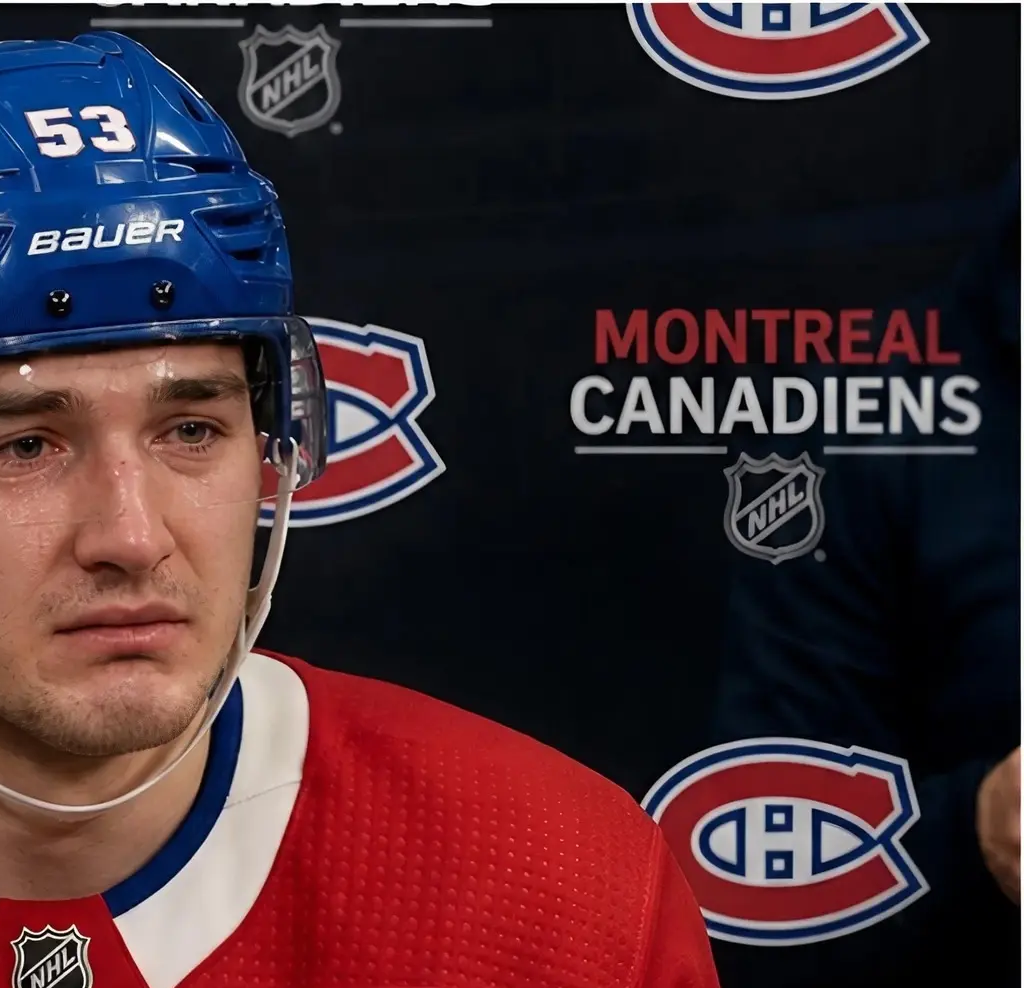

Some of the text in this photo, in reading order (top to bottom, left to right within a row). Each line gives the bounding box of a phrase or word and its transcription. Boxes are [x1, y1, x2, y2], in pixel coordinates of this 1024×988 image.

[262, 54, 319, 110] NHL
[24, 106, 136, 158] 53
[595, 309, 961, 364] MONTREAL
[570, 375, 982, 435] CANADIENS
[747, 480, 805, 538] NHL
